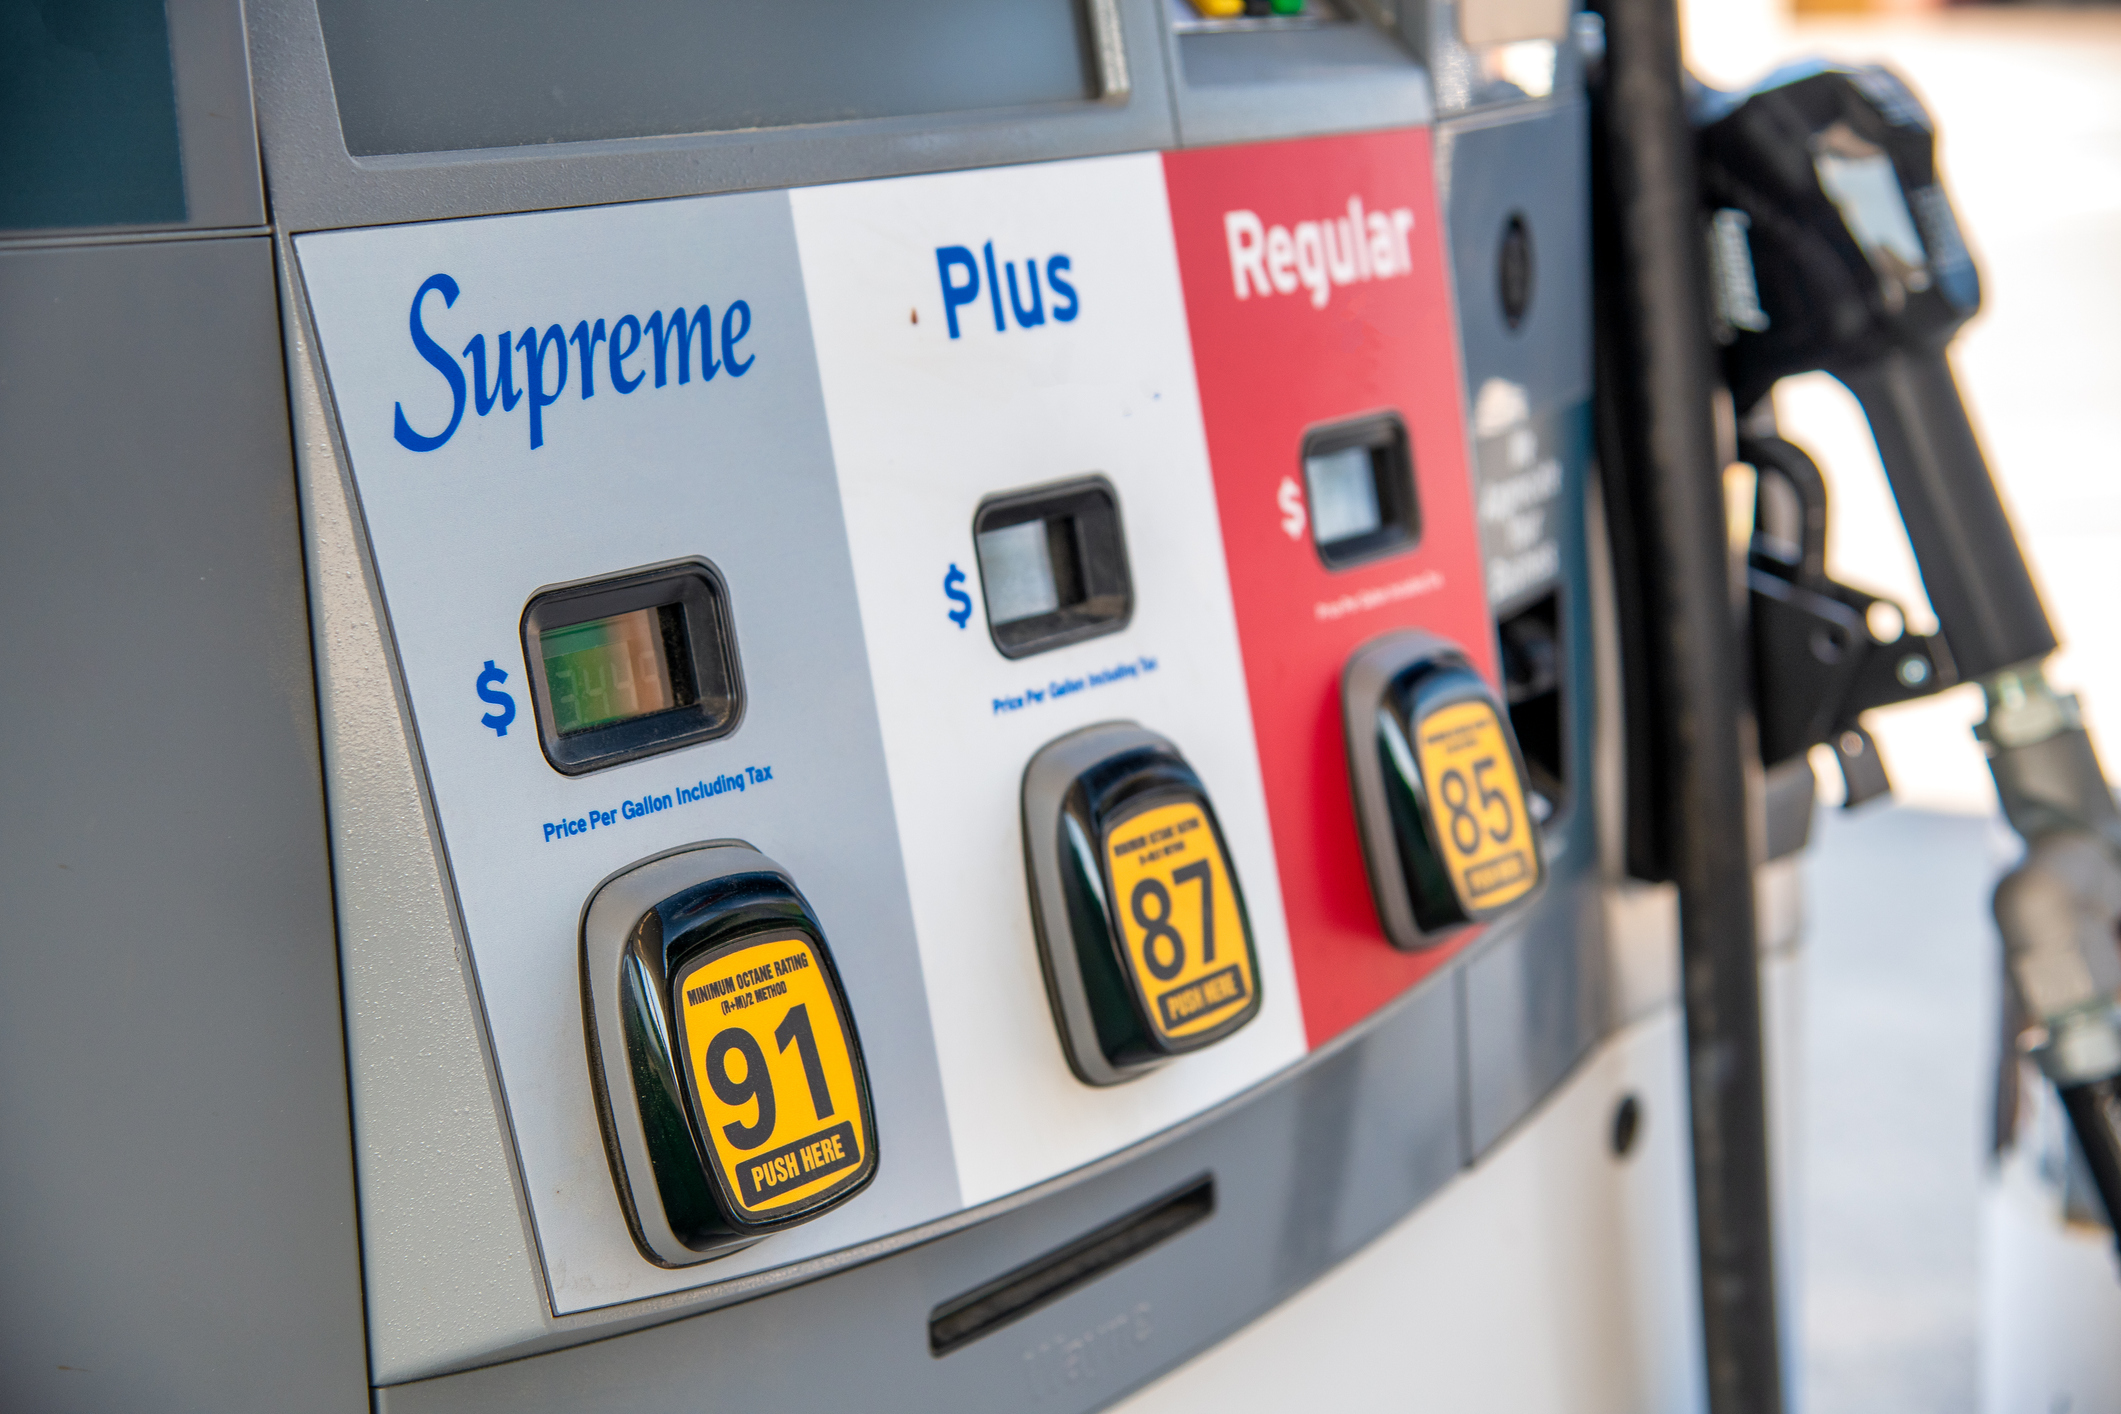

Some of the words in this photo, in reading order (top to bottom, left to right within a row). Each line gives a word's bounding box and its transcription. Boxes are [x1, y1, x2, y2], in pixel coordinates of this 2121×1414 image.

[936, 239, 1079, 339] Plus
[1225, 196, 1413, 309] Regular
[394, 273, 755, 452] Supreme
[1277, 476, 1306, 541] $
[944, 564, 972, 629] $
[476, 660, 516, 737] $
[543, 819, 587, 842] Price
[589, 809, 617, 830] Per
[622, 794, 673, 820] Gallon
[676, 774, 744, 805] Including
[745, 766, 773, 785] Tax
[1441, 757, 1513, 856] 85
[1130, 859, 1215, 981] 87
[686, 976, 736, 1007] MINIMUM
[736, 964, 774, 990] OCTANE
[774, 952, 809, 977] RATING
[721, 992, 754, 1016] (R+M)/2
[754, 981, 787, 1003] METHOD
[705, 1003, 834, 1150] 91
[751, 1154, 799, 1192] PUSH
[800, 1134, 845, 1172] HERE
